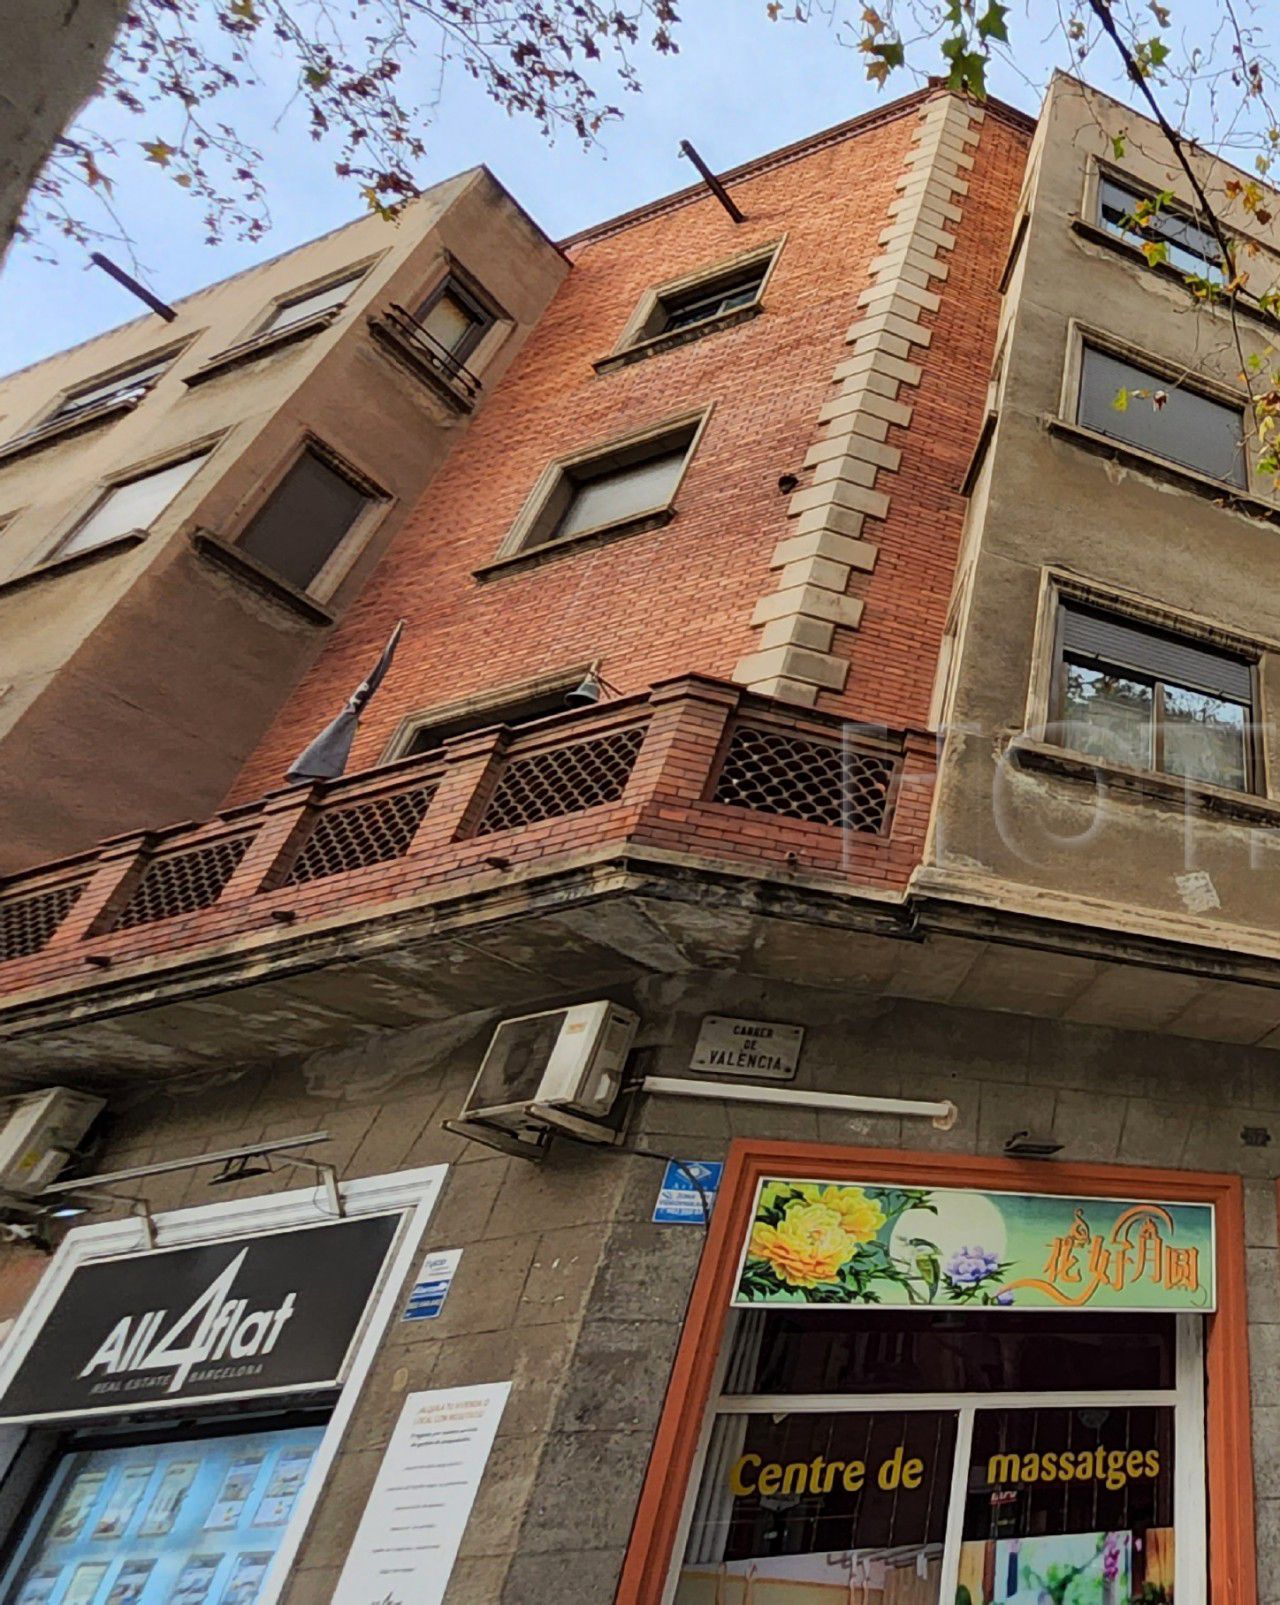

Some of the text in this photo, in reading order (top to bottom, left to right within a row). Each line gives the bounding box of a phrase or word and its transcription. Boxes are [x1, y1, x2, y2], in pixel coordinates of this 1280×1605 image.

[733, 1025, 774, 1038] CARRER
[744, 1039, 757, 1051] DE
[90, 1363, 264, 1396] REAL ESTATE BARCELONA
[728, 1445, 1160, 1496] Centre de massatges
